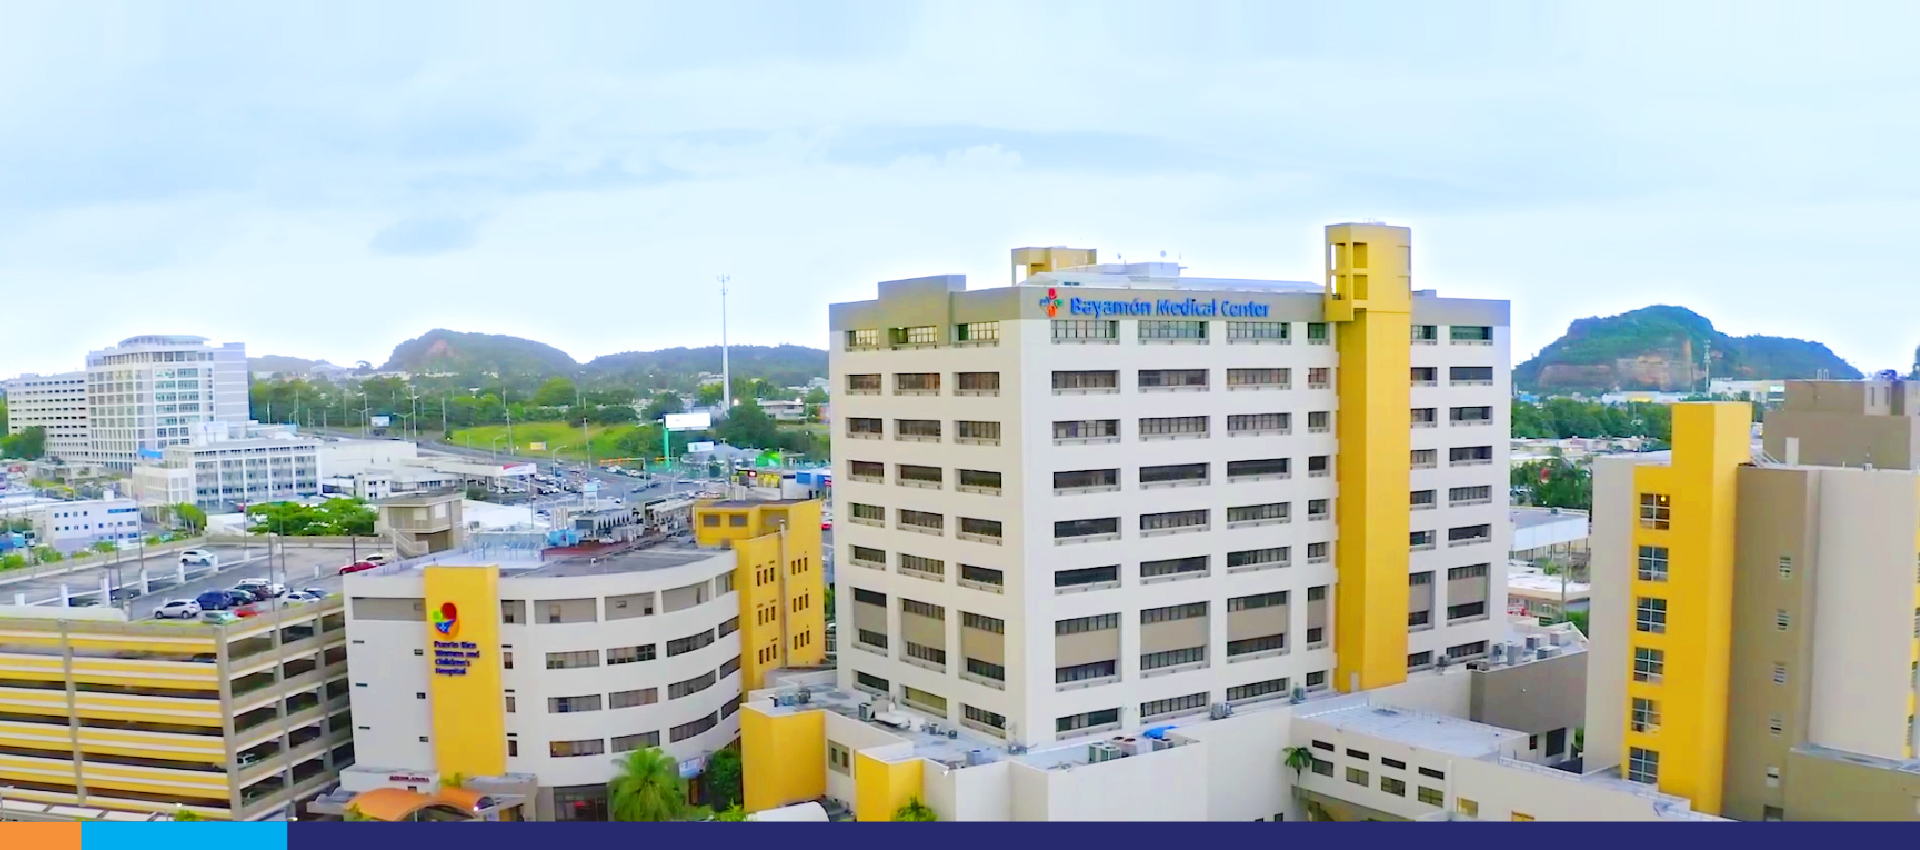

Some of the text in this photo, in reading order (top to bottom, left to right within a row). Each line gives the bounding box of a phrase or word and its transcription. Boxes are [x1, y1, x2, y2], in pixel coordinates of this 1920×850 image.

[1070, 297, 1270, 319] Bayamón Medical Center
[466, 650, 479, 658] and
